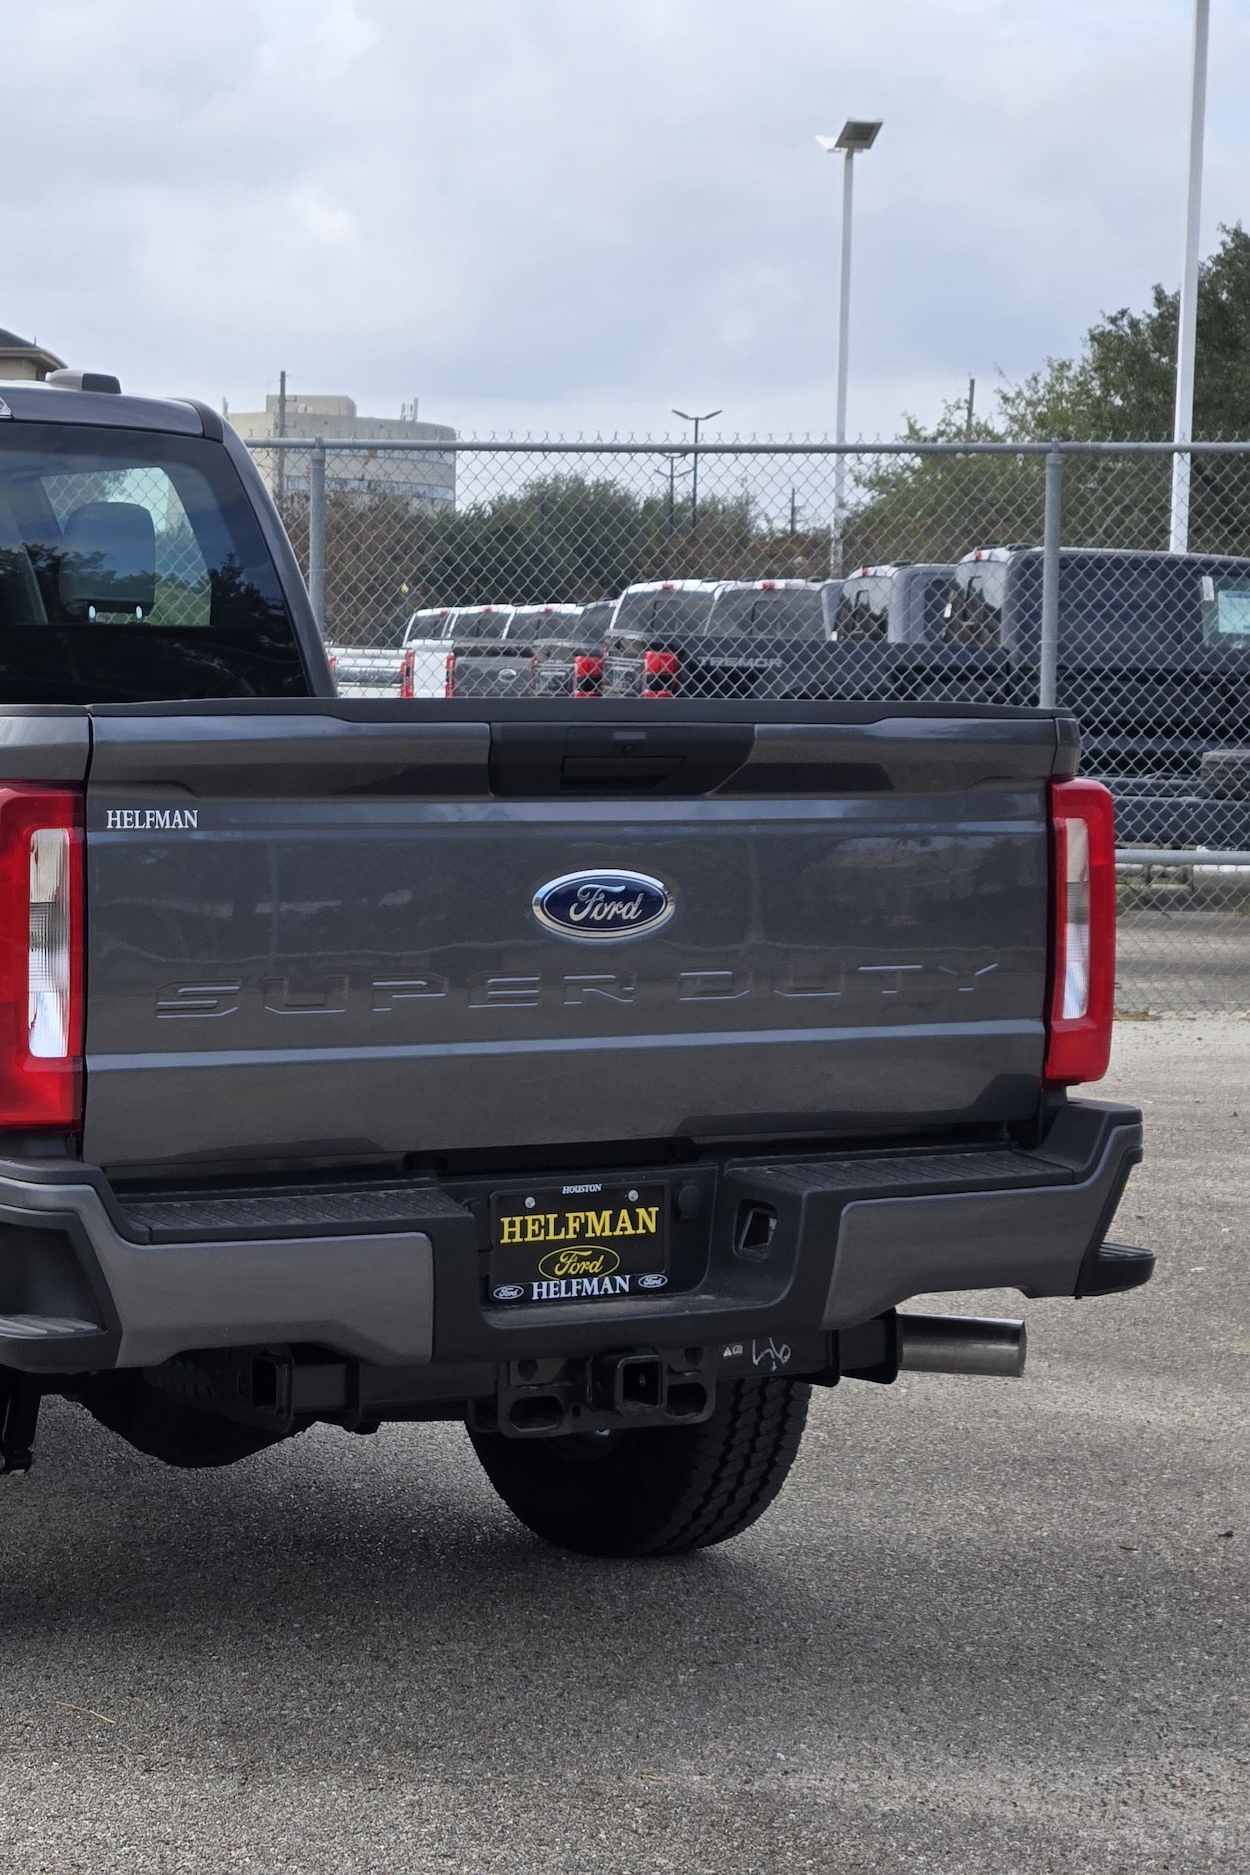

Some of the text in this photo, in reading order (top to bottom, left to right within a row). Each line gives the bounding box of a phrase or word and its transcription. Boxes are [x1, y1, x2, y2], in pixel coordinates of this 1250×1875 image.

[697, 656, 784, 668] TREMOR
[106, 809, 198, 829] HELFMAN
[568, 884, 646, 925] Ford
[154, 961, 1001, 1019] SUPER DUTY
[561, 1183, 603, 1195] HOUSTON
[499, 1206, 660, 1245] HELFMAN
[553, 1249, 605, 1276] Ford
[531, 1275, 631, 1301] HELFMAN
